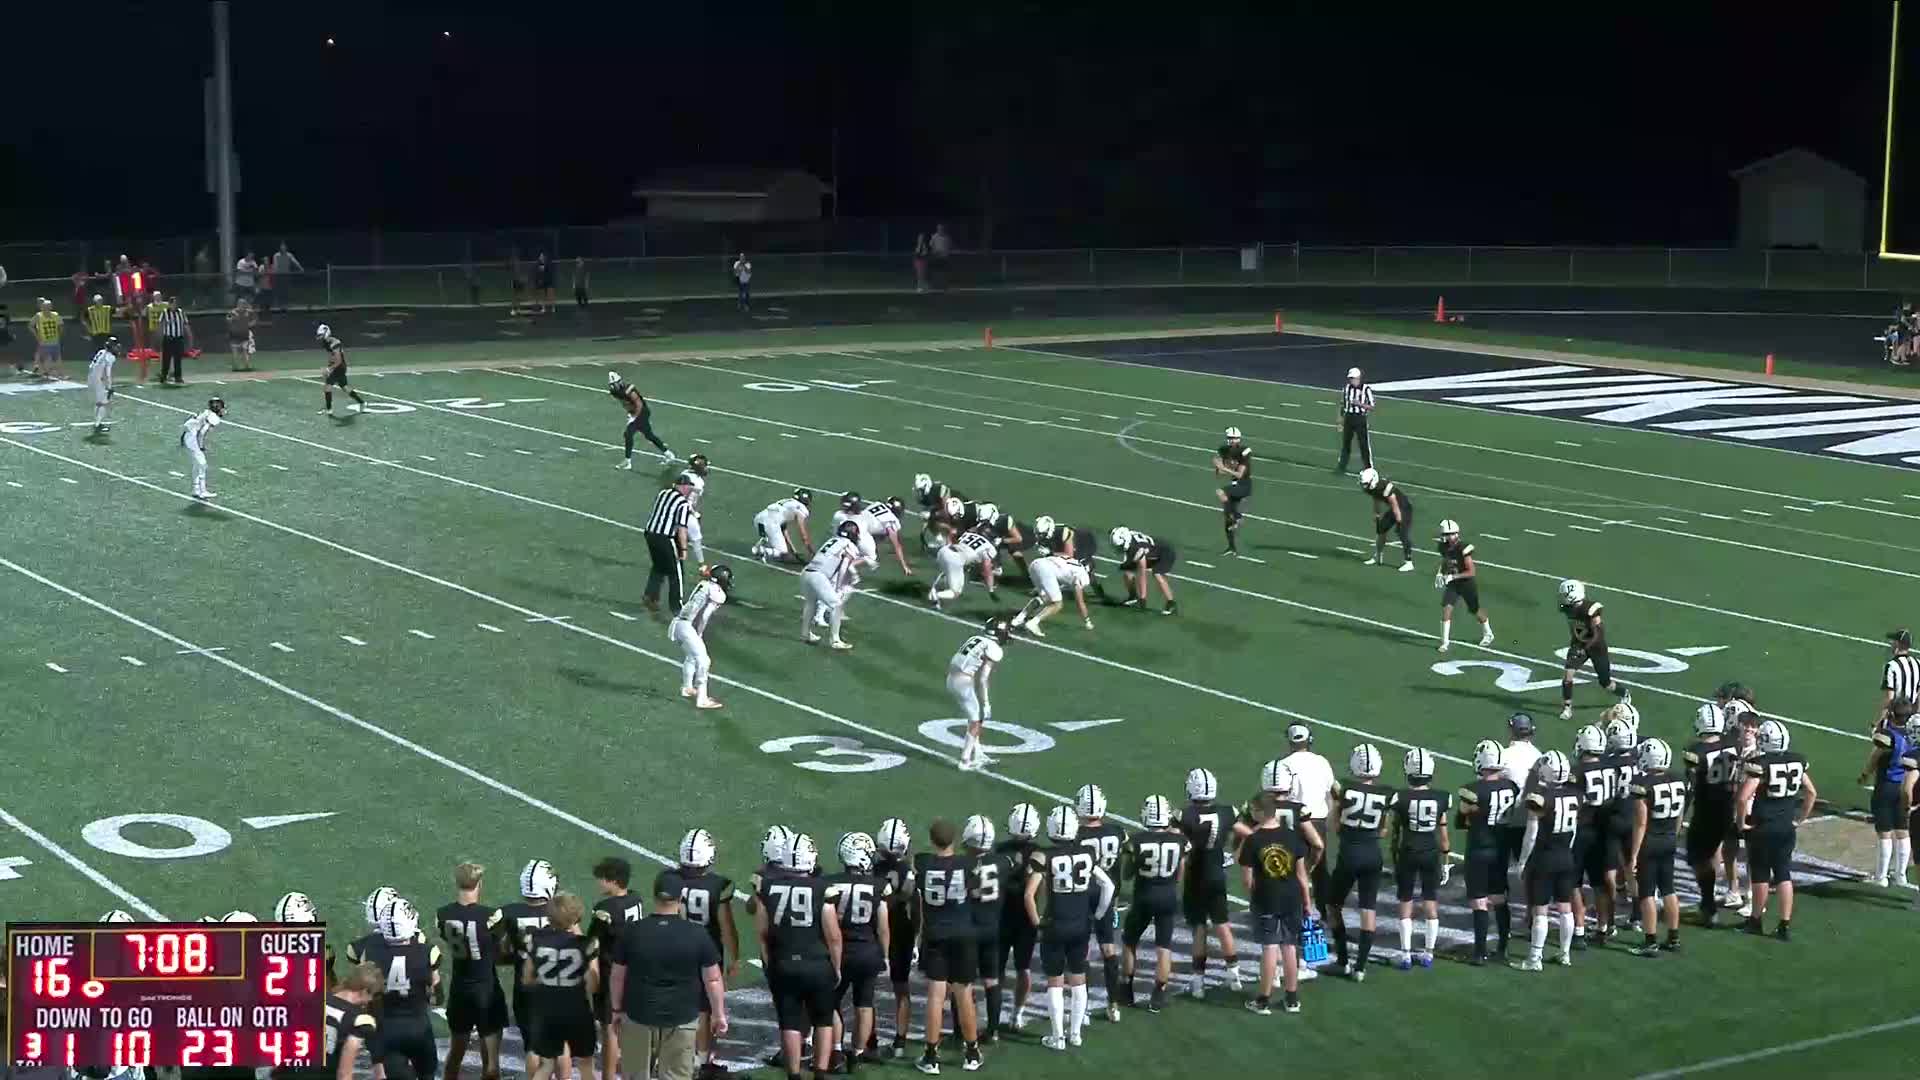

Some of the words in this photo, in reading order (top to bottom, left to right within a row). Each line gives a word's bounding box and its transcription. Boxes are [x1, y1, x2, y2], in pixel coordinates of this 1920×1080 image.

[759, 717, 1056, 773] 30
[1768, 762, 1804, 798] 53
[1341, 790, 1386, 829] 25
[1553, 796, 1579, 833] 16
[1653, 781, 1685, 819] 55
[1199, 813, 1219, 849] 7
[1051, 853, 1092, 893] 83
[1139, 842, 1180, 878] 30
[768, 884, 813, 927] 79
[837, 883, 875, 924] 76
[384, 956, 411, 996] 4
[536, 947, 584, 987] 22
